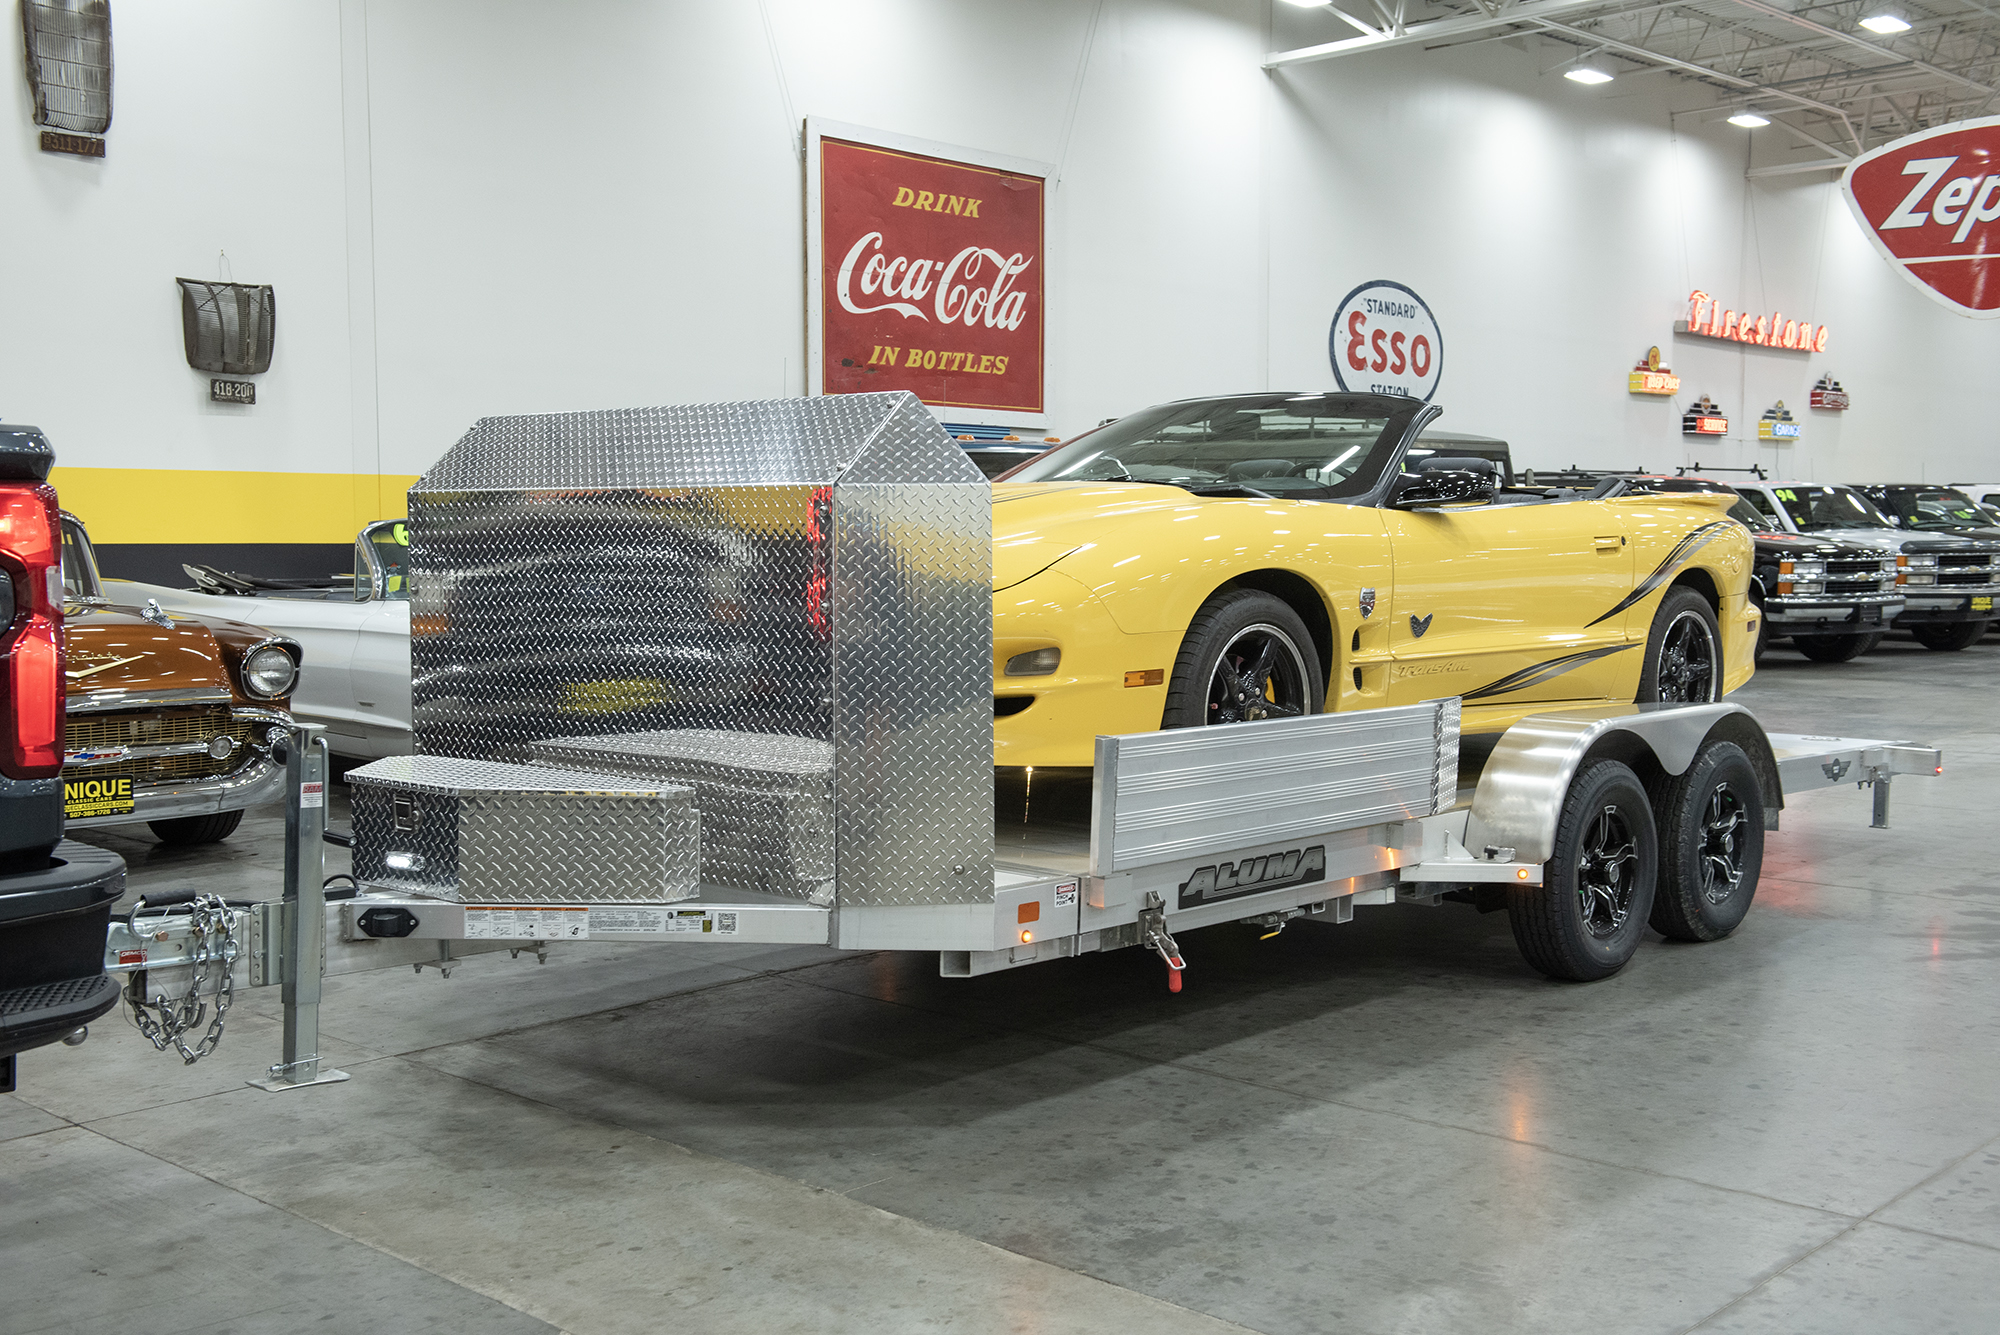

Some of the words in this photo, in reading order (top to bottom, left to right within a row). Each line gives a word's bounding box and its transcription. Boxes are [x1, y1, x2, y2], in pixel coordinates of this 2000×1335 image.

[892, 186, 982, 219] DRINK
[836, 231, 1034, 332] Coca-Cola
[1689, 289, 1829, 353] Firestone
[868, 345, 901, 366] IN
[905, 348, 1009, 376] BOTTLES
[64, 779, 132, 800] NIQUE
[67, 797, 94, 805] CLASSIC
[1182, 848, 1324, 900] ALUMA
